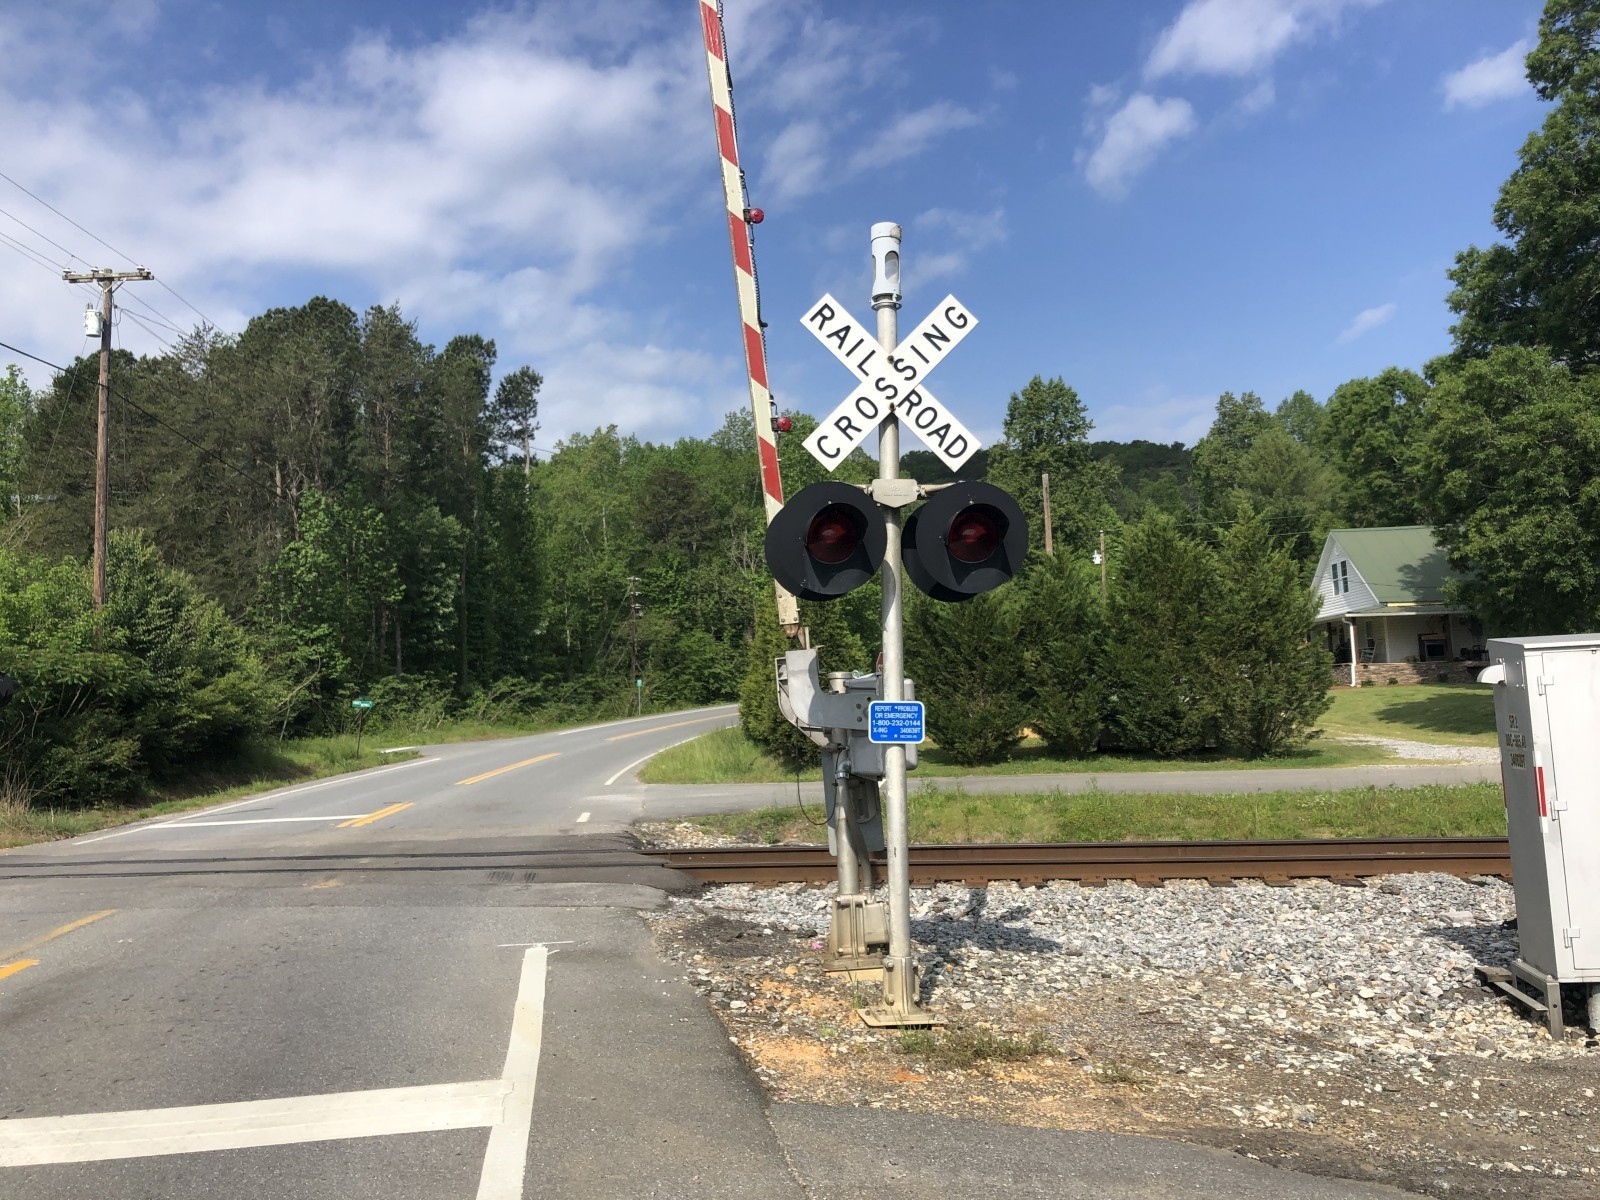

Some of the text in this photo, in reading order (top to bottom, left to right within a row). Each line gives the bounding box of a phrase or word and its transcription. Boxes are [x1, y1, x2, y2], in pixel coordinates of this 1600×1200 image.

[809, 302, 876, 377] RAIL
[816, 306, 968, 459] CROSSING
[872, 719, 921, 727] 1-800-232-0144
[872, 726, 888, 734] X-ING
